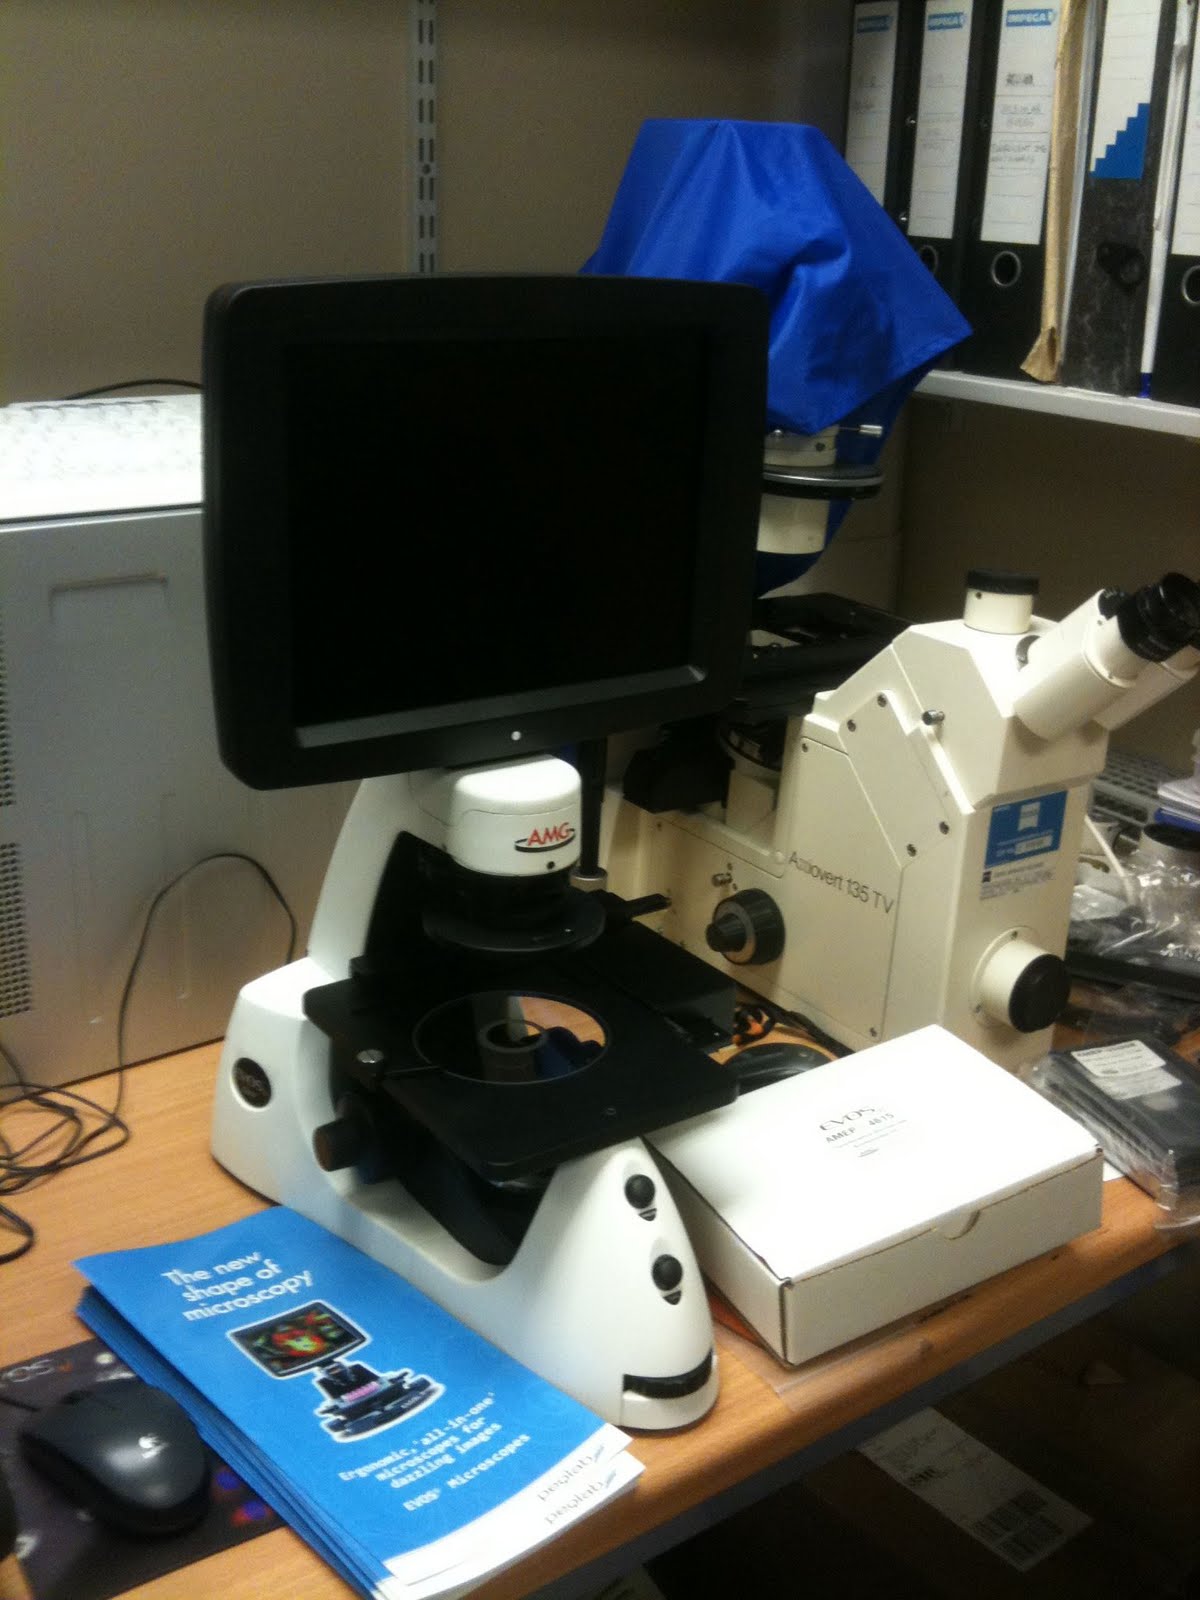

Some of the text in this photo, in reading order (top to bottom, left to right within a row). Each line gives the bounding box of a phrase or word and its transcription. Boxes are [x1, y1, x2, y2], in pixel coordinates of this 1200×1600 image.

[527, 822, 573, 846] AMG
[847, 878, 870, 902] 135
[873, 890, 895, 914] TV
[161, 1251, 261, 1286] The new
[182, 1258, 282, 1302] shape of
[182, 1270, 313, 1321] microscopy
[462, 1416, 486, 1435] for
[390, 1422, 503, 1489] dazzling images
